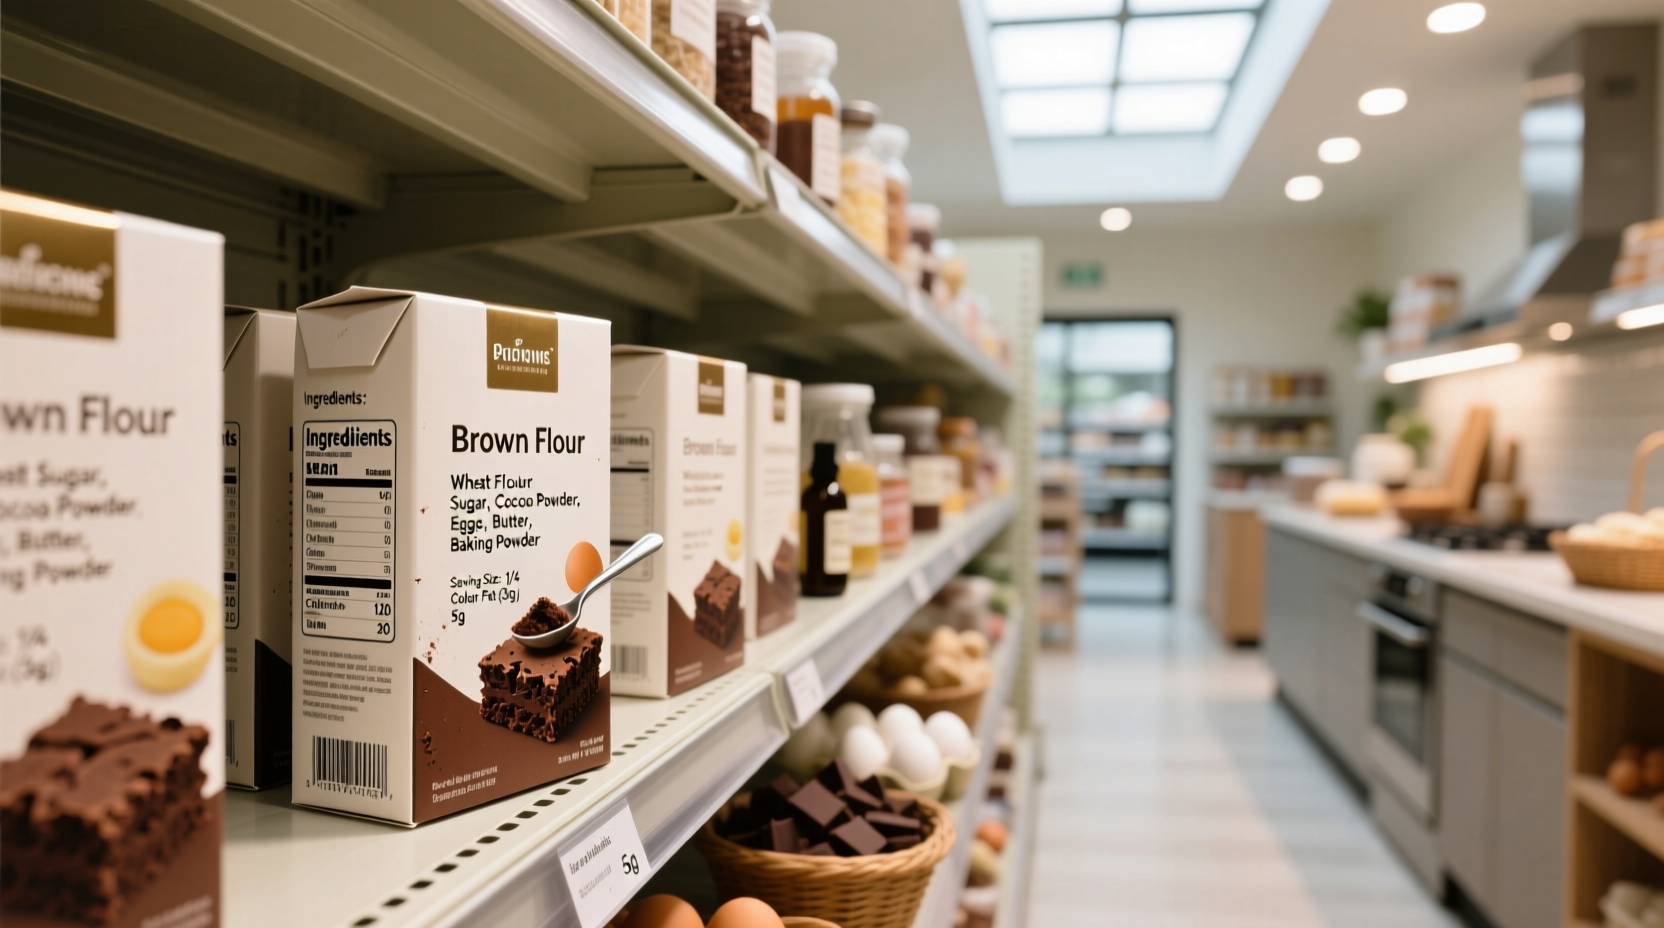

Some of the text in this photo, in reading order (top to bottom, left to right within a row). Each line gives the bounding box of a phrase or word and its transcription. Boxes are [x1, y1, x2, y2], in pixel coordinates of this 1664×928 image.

[80, 394, 175, 434] Flour
[451, 424, 585, 454] Brown Flour
[450, 473, 491, 490] Wheat
[450, 495, 491, 514] Sugar,
[536, 492, 581, 508] Powder,
[492, 514, 533, 530] Butter,
[450, 531, 541, 554] Baking Powder
[505, 570, 520, 586] 1/4
[499, 587, 520, 604] (3g)
[451, 609, 465, 626] 5g
[377, 622, 390, 635] 20
